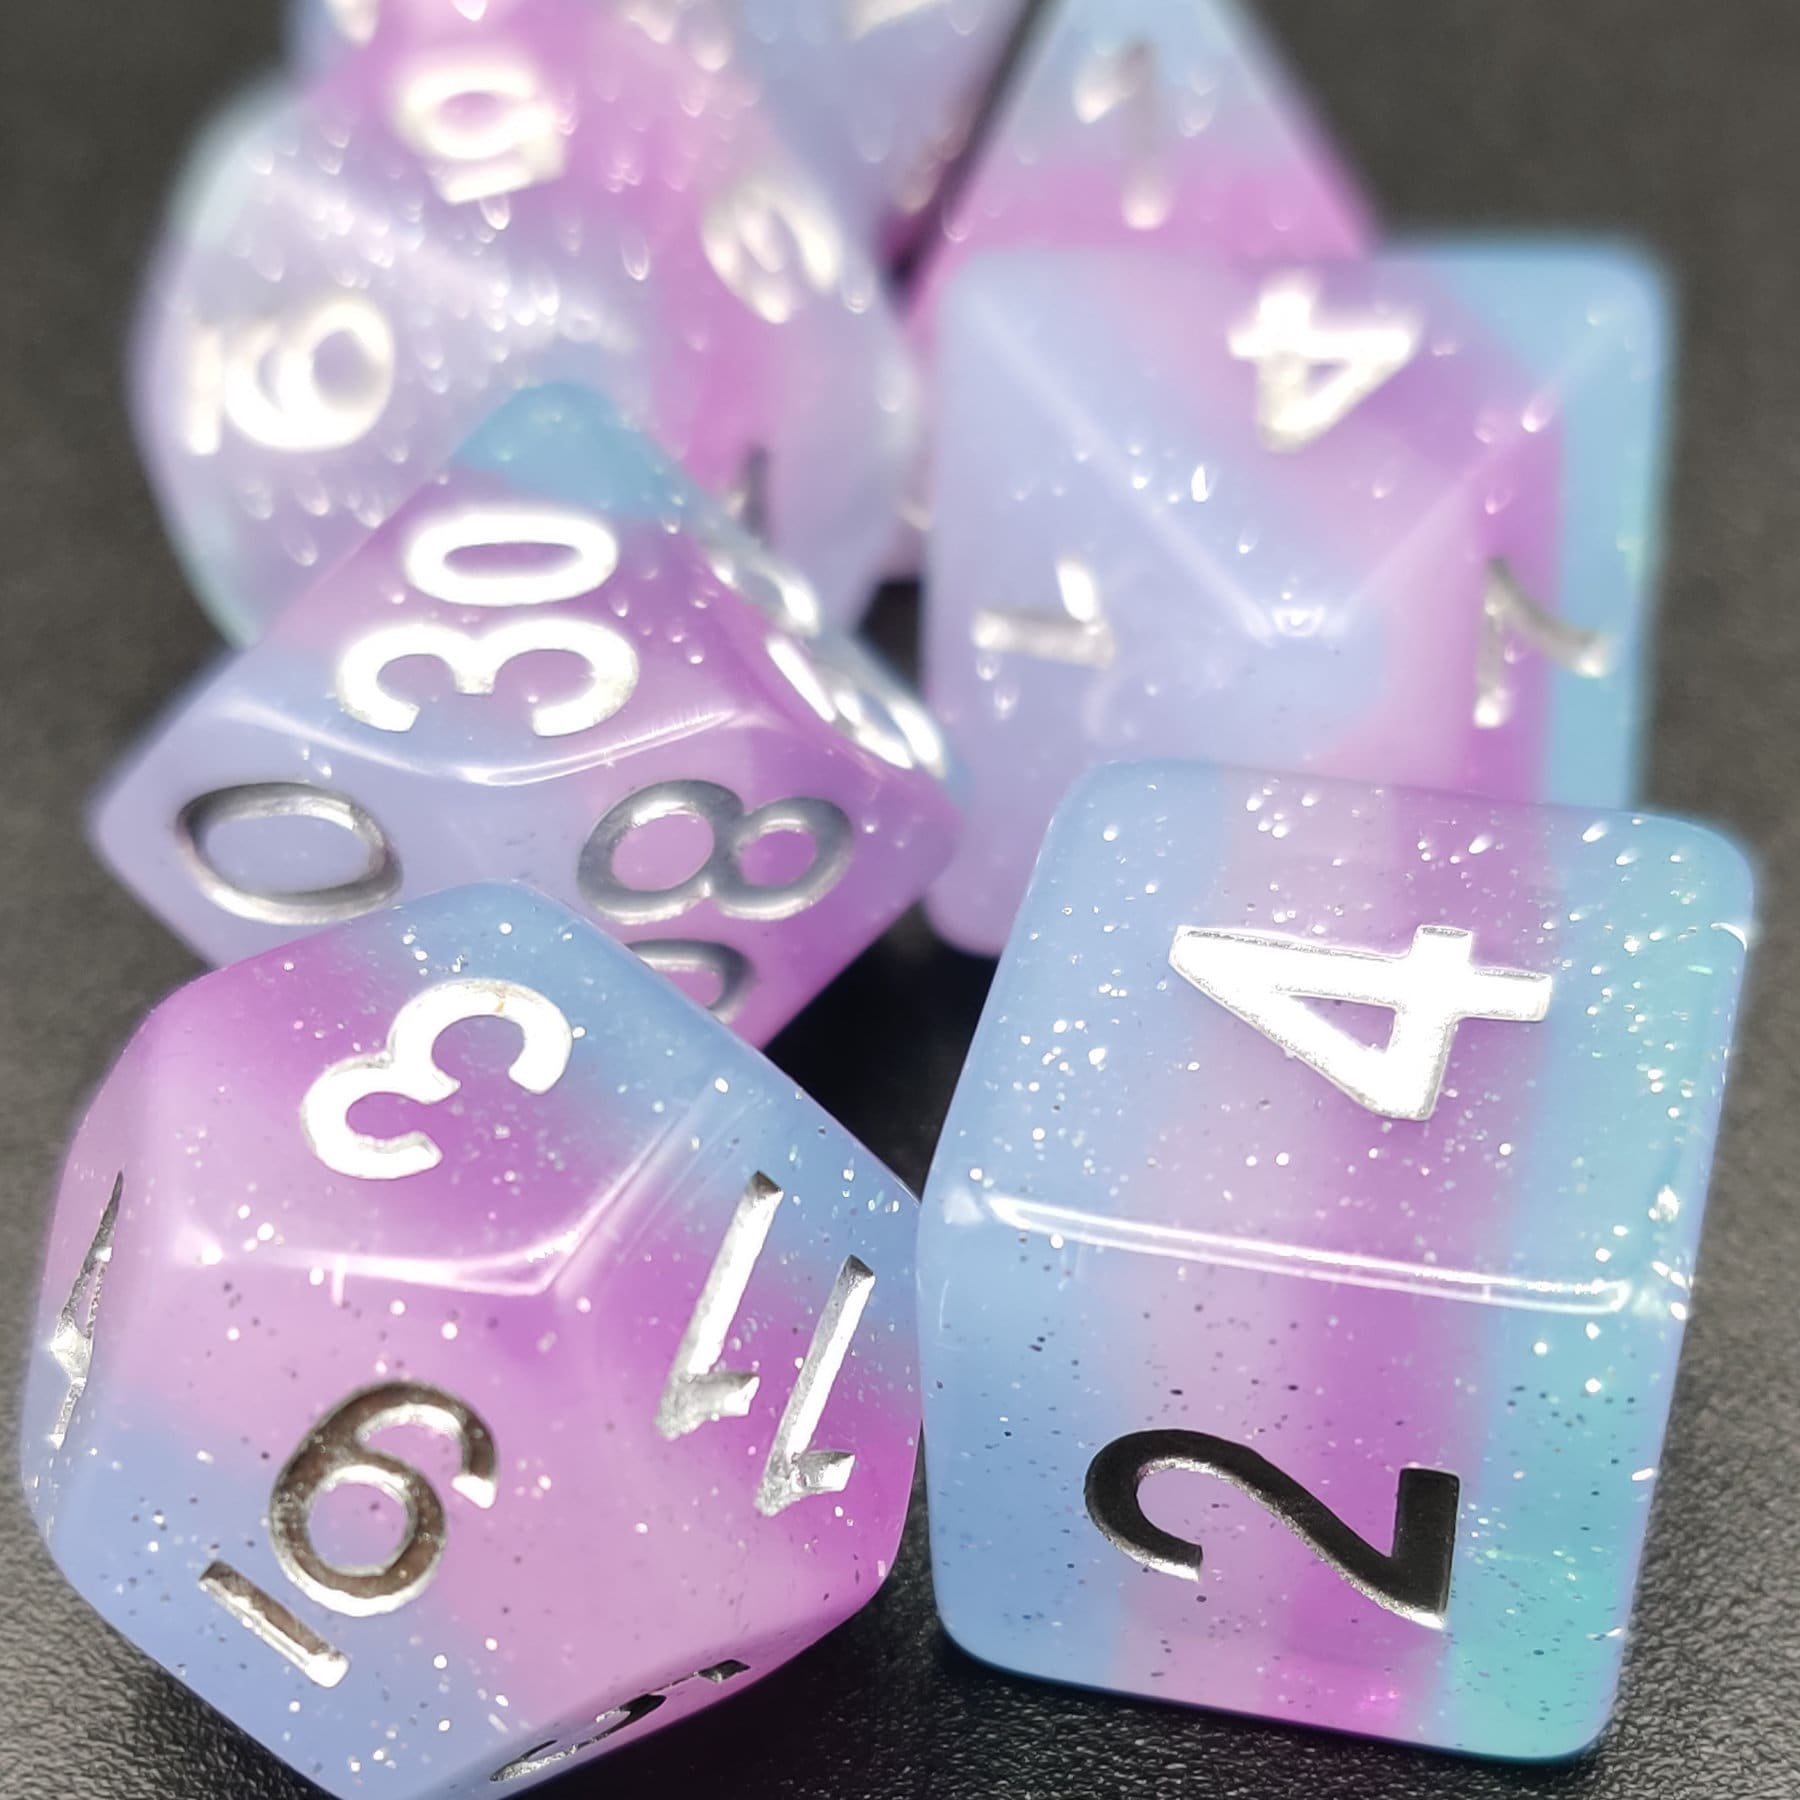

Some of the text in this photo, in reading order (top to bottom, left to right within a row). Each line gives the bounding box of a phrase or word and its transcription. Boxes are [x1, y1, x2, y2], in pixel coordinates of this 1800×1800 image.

[1228, 277, 1418, 450] 4
[336, 509, 640, 737] 30
[299, 979, 573, 1180] 3
[1168, 925, 1552, 1121] 4
[655, 1170, 877, 1517] 11
[1085, 1428, 1461, 1630] 2
